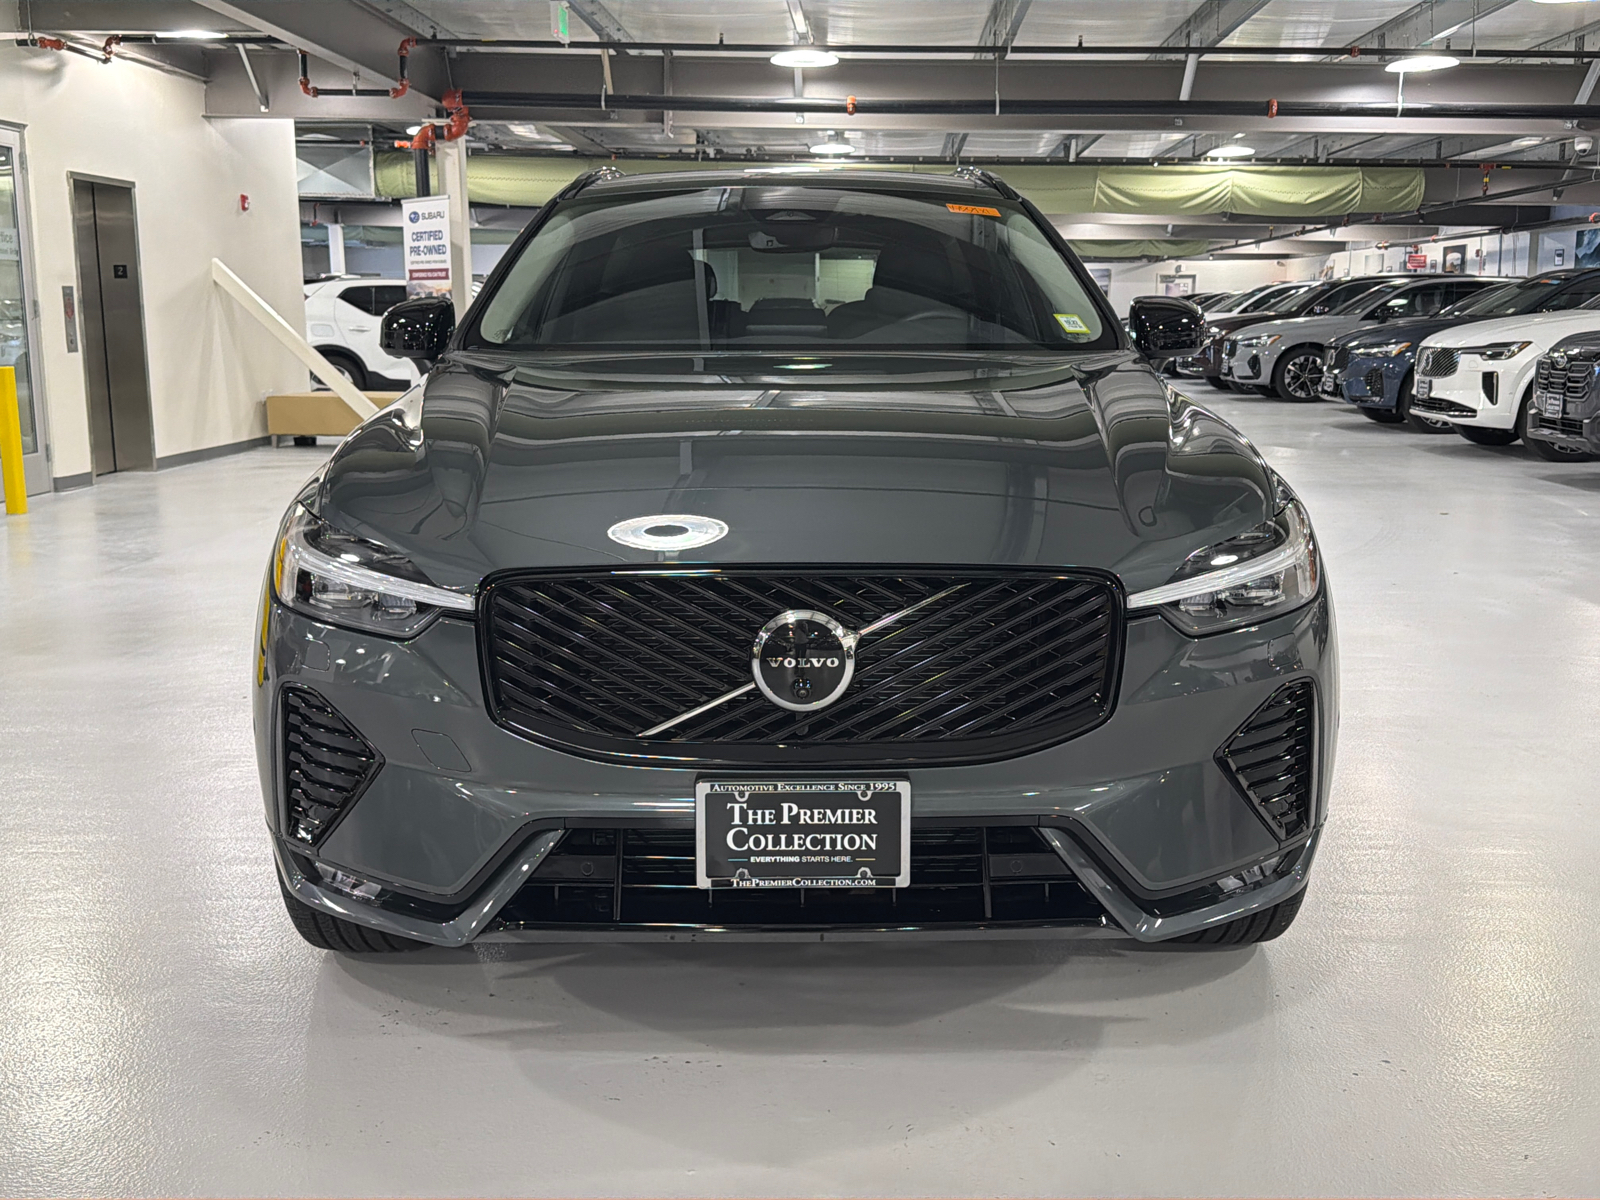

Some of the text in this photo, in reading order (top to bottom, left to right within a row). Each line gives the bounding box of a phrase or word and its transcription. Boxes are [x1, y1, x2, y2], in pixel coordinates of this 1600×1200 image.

[421, 211, 445, 221] SUBARU
[411, 230, 444, 242] CERTIFIED
[409, 244, 447, 257] PRE-OWNED
[117, 266, 124, 275] 2
[766, 657, 840, 668] VOLVO
[869, 782, 896, 791] 1995
[726, 802, 878, 825] THE PREMIER
[726, 827, 878, 851] COLLECTION
